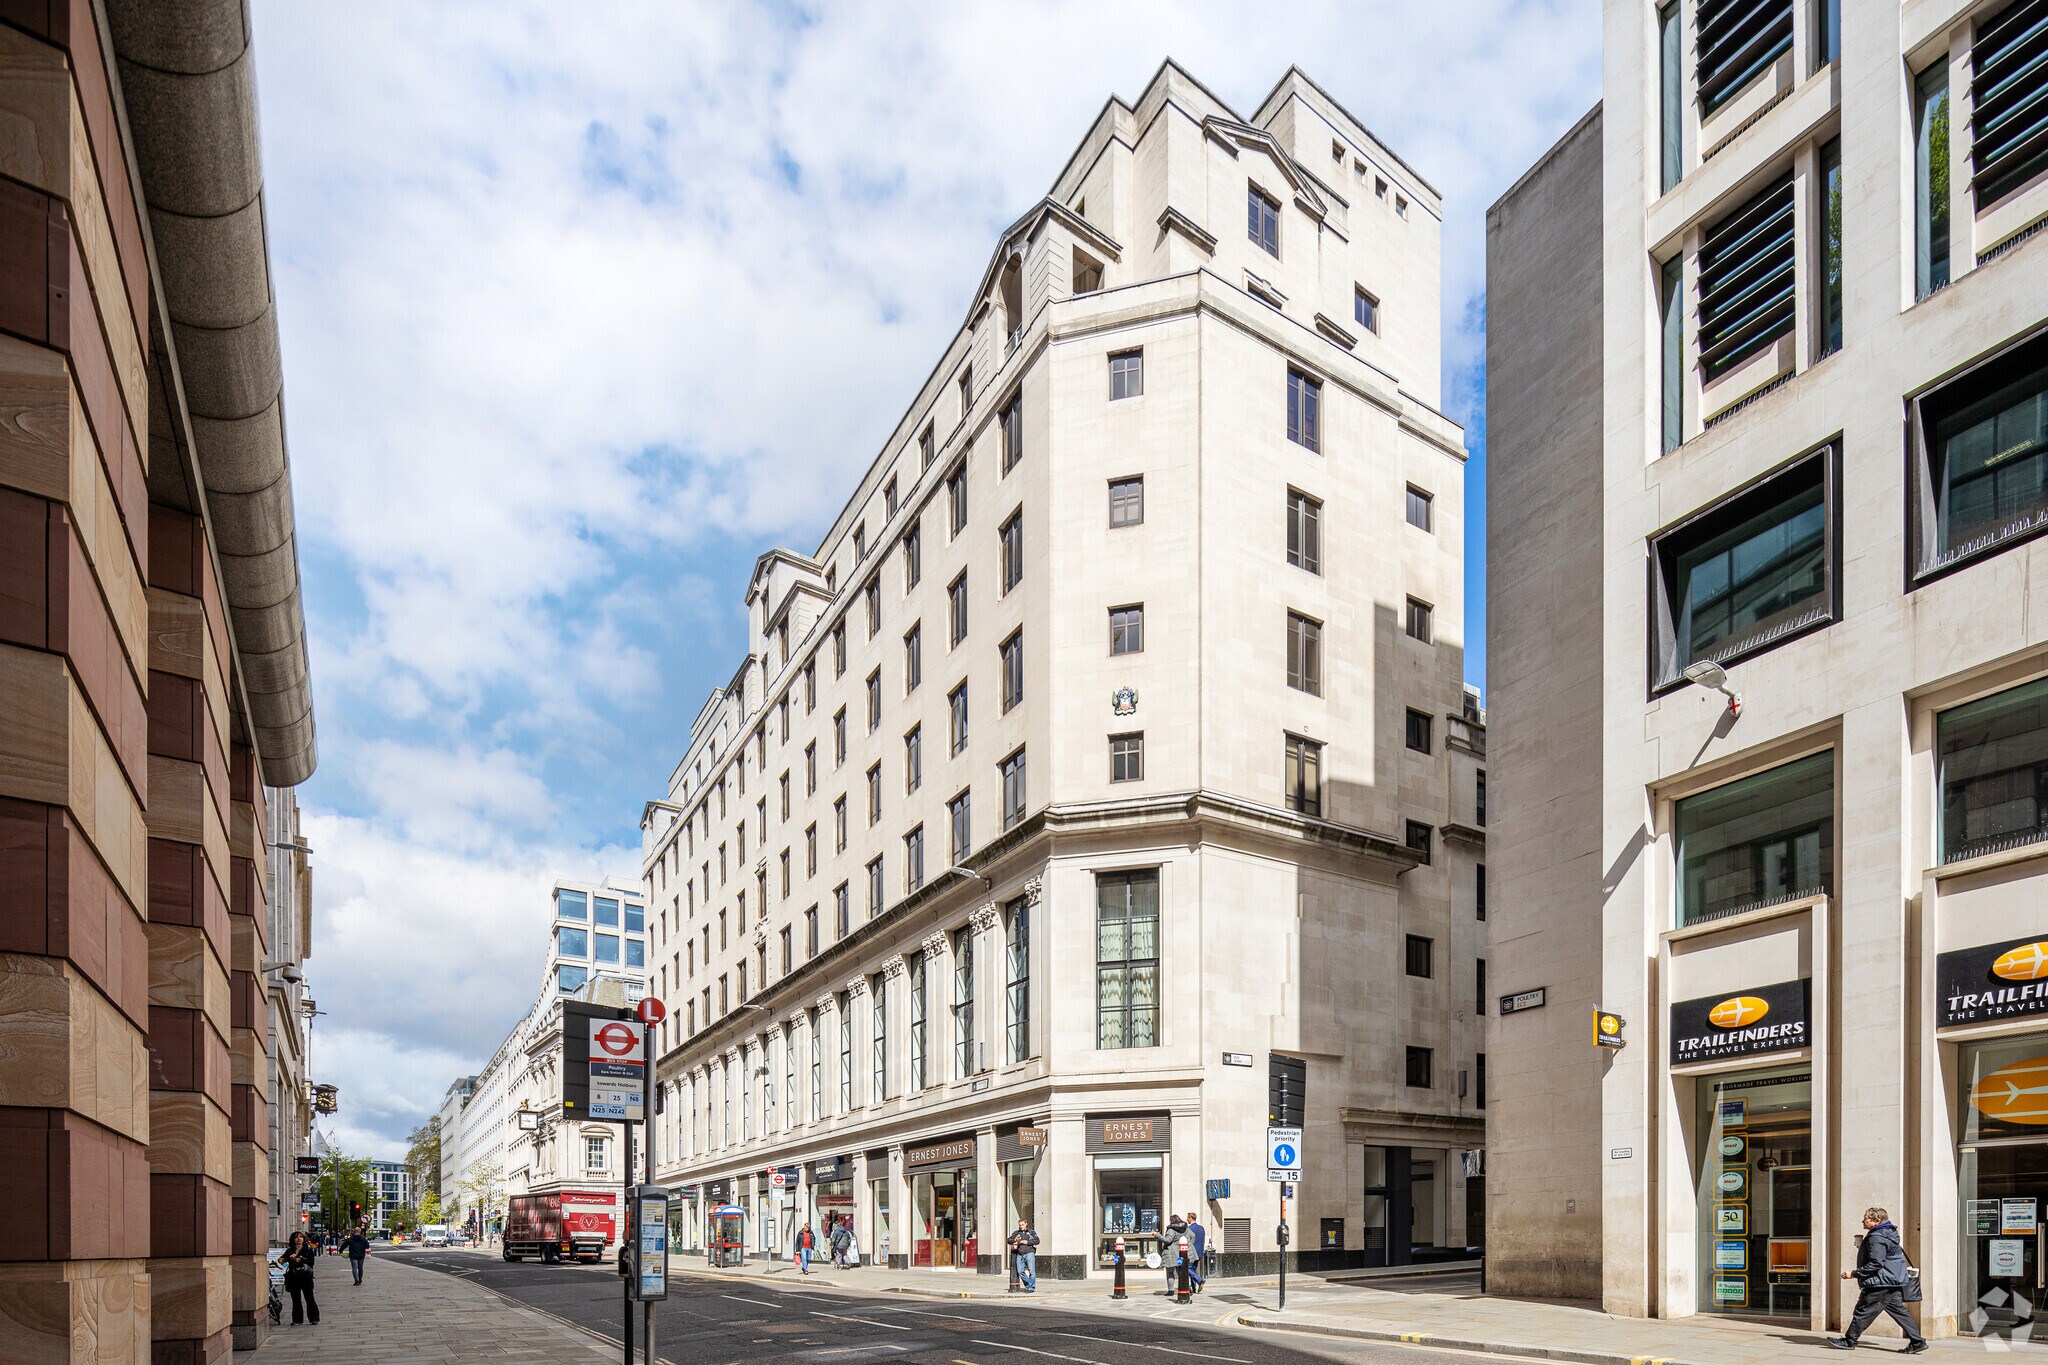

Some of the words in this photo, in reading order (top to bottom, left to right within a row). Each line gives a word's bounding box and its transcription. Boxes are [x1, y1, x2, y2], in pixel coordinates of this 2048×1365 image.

[1516, 992, 1539, 1002] POULTRY
[646, 1001, 660, 1020] L
[1948, 1010, 1975, 1020] THE
[1986, 1001, 2045, 1015] TRAVEL
[1677, 1021, 1805, 1051] TRAILFINDERS
[1678, 1052, 1698, 1060] THE
[1704, 1045, 1746, 1056] TRAVEL
[1753, 1036, 1805, 1049] EXPERTS
[1105, 1122, 1151, 1131] ERNEST
[1109, 1131, 1147, 1140] JONES
[911, 1148, 940, 1162] ERNEST
[942, 1143, 969, 1157] JONES
[1287, 1171, 1298, 1180] 15
[1723, 1211, 1738, 1222] 50
[585, 1218, 594, 1227] V
